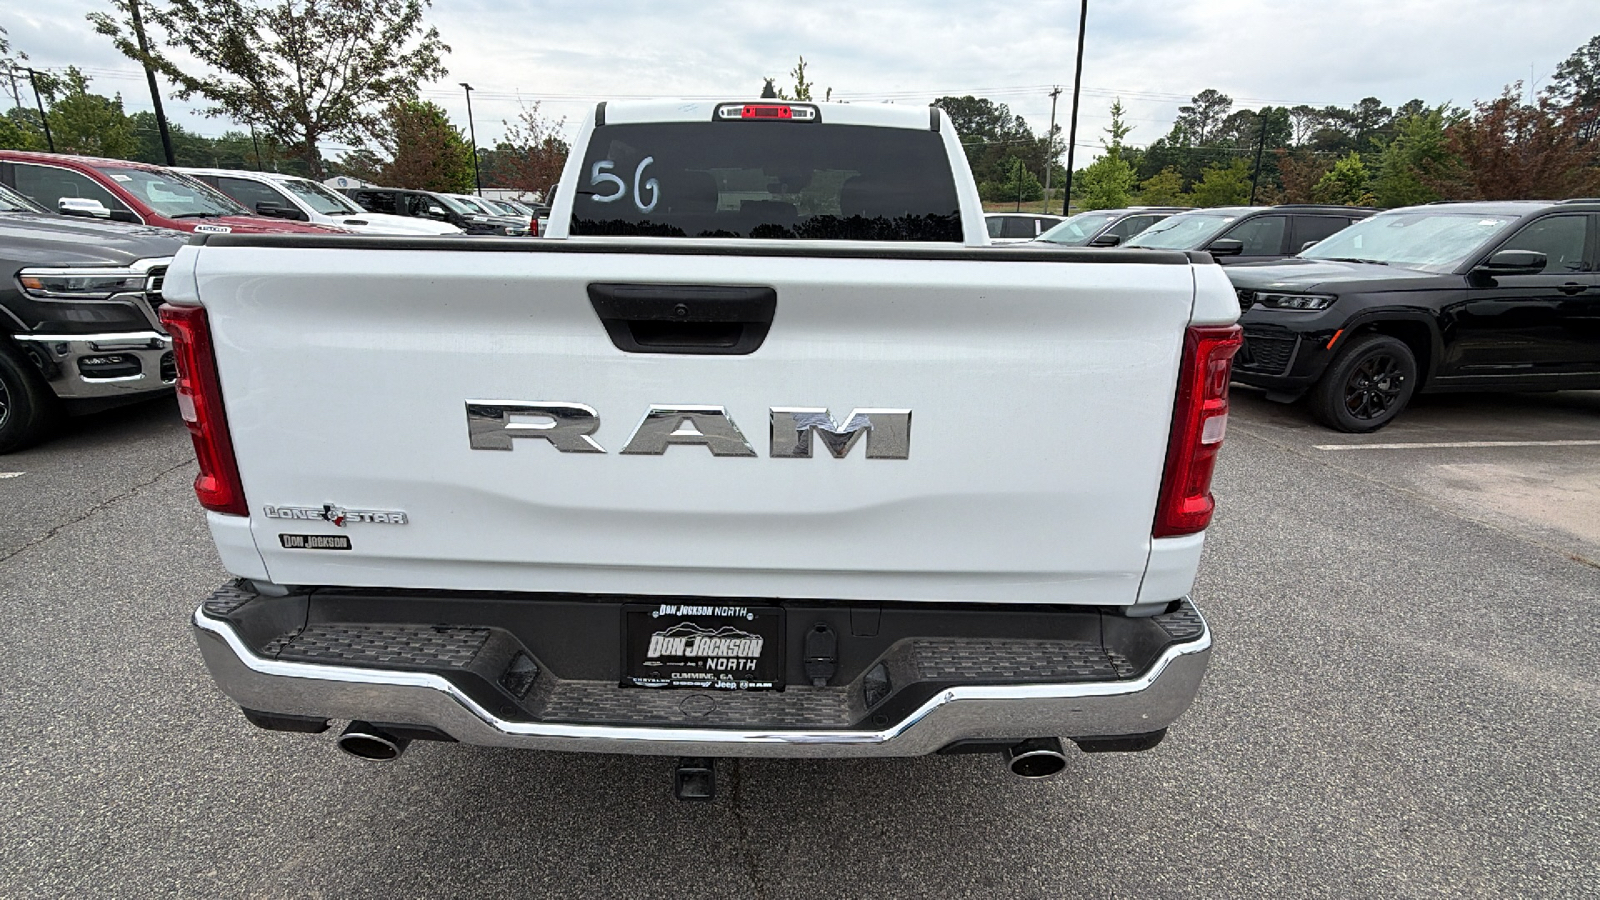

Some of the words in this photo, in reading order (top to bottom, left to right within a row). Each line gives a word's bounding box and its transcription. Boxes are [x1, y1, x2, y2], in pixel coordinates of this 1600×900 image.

[464, 398, 913, 460] RAM
[263, 504, 323, 520] LONE
[346, 511, 409, 525] STAR
[714, 606, 747, 617] NORTH
[647, 635, 686, 658] DON
[684, 635, 764, 658] JACKSON
[706, 658, 757, 670] NORTH
[671, 672, 717, 680] CUMMING,
[714, 680, 737, 690] Jeep
